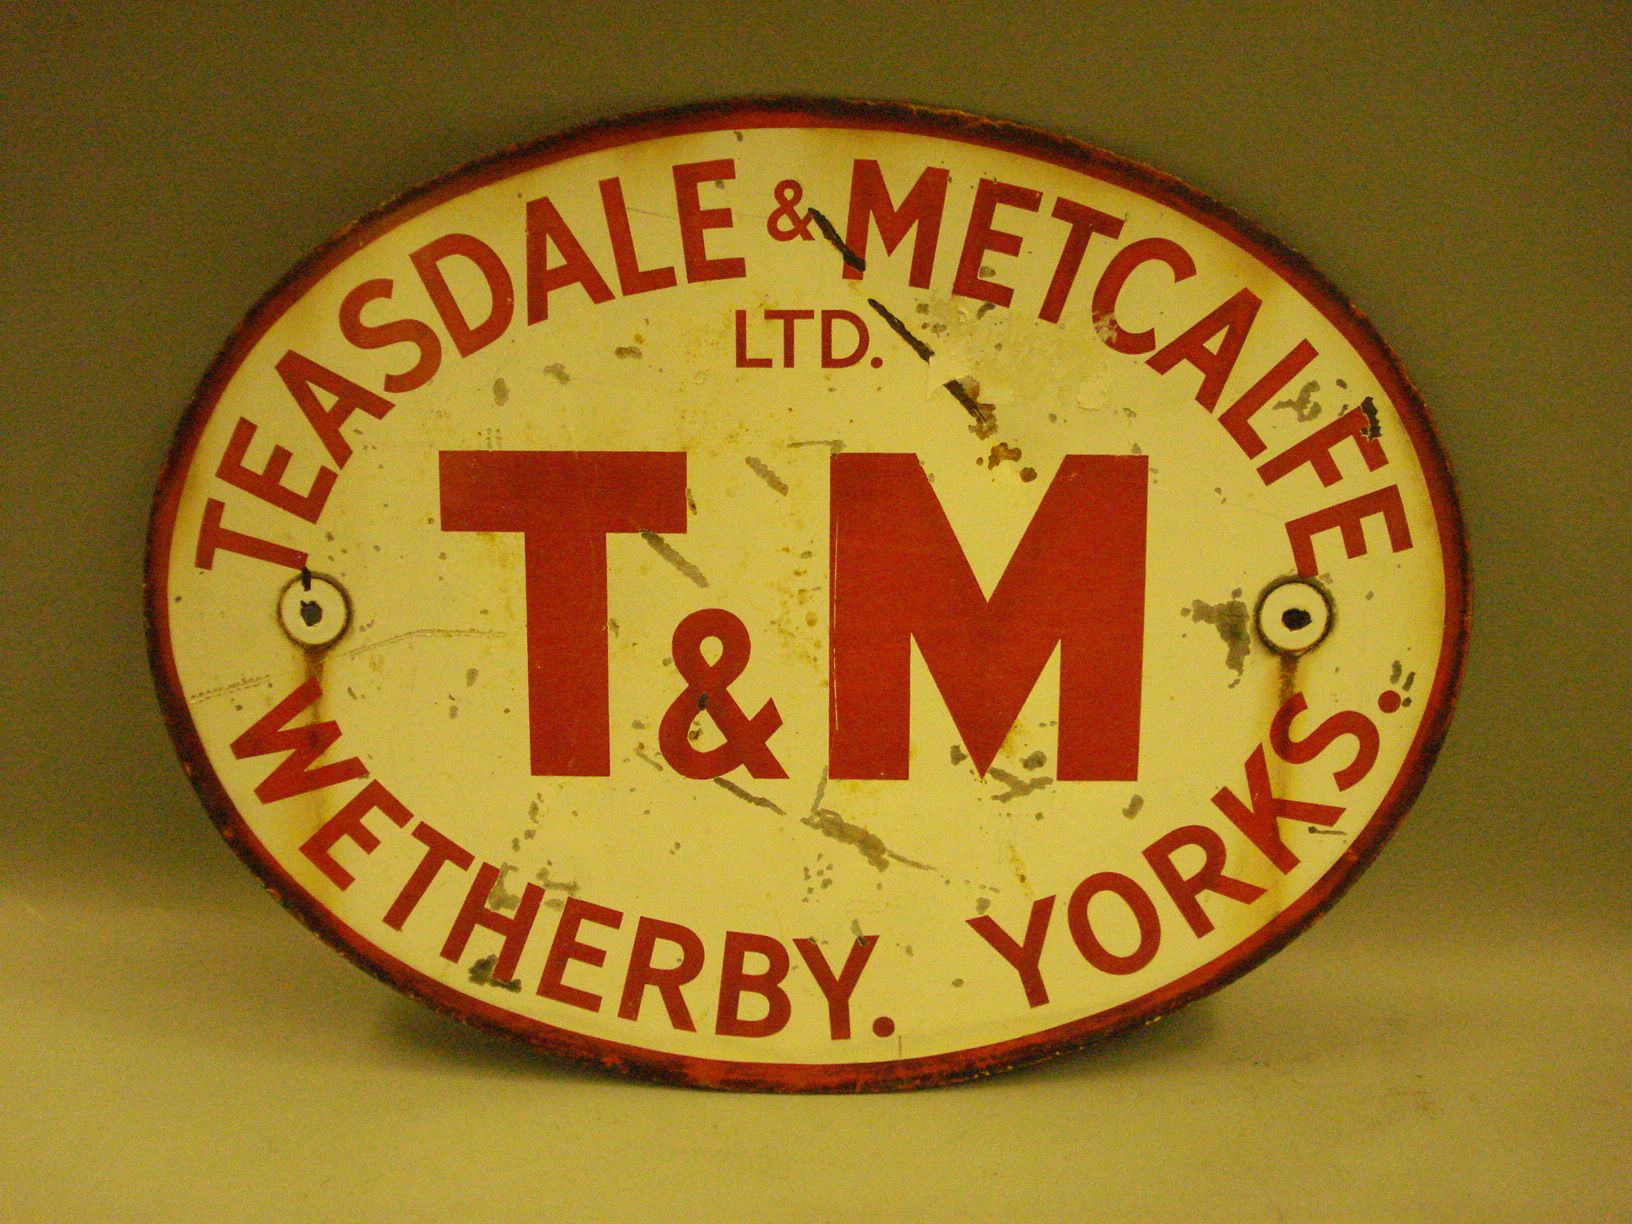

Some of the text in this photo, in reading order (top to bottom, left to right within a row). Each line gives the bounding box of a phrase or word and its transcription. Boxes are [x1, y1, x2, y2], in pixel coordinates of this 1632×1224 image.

[195, 159, 1414, 577] TEASDALE & METCALFE
[735, 309, 884, 369] LTD.
[230, 678, 1401, 1040] WETHERBY. YORKS.
